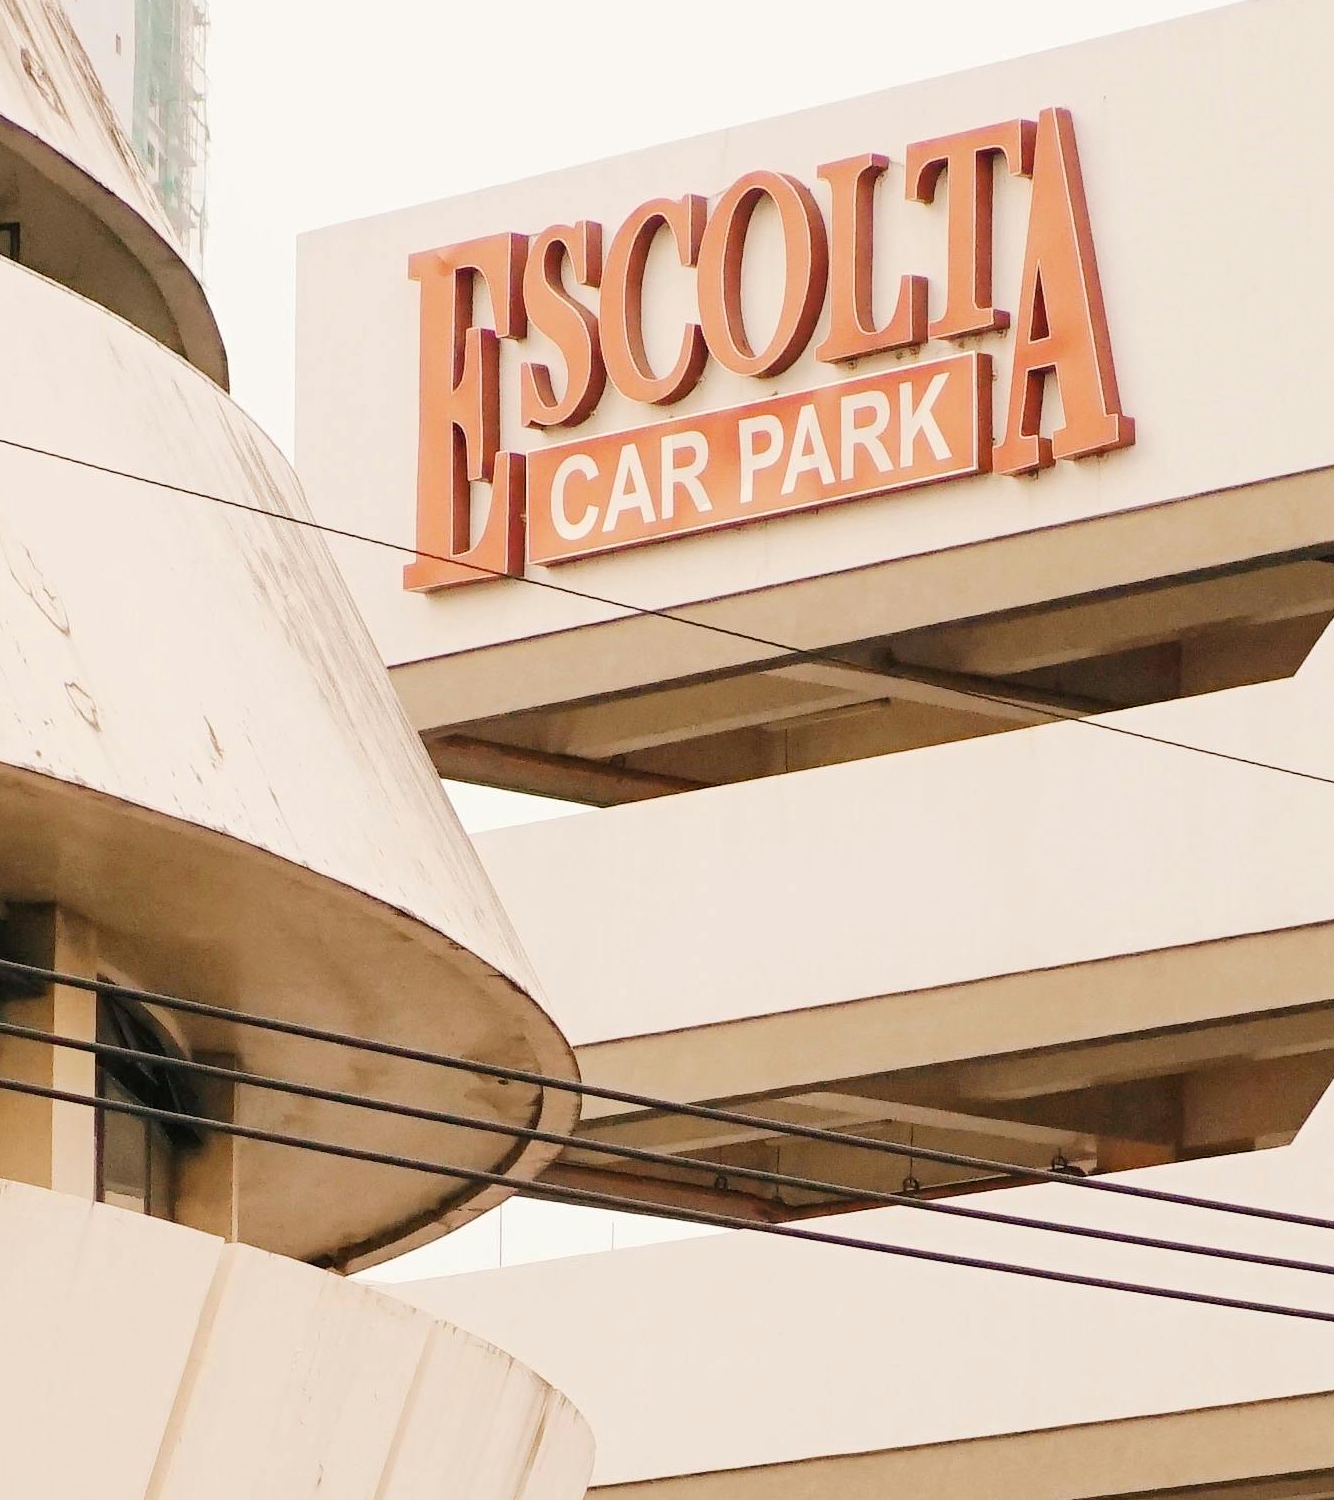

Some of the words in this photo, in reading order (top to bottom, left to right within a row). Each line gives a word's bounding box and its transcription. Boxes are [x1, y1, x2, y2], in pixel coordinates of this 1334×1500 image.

[403, 106, 1135, 592] ESCOLTA
[550, 430, 713, 540] CAR
[740, 372, 953, 505] PARK
